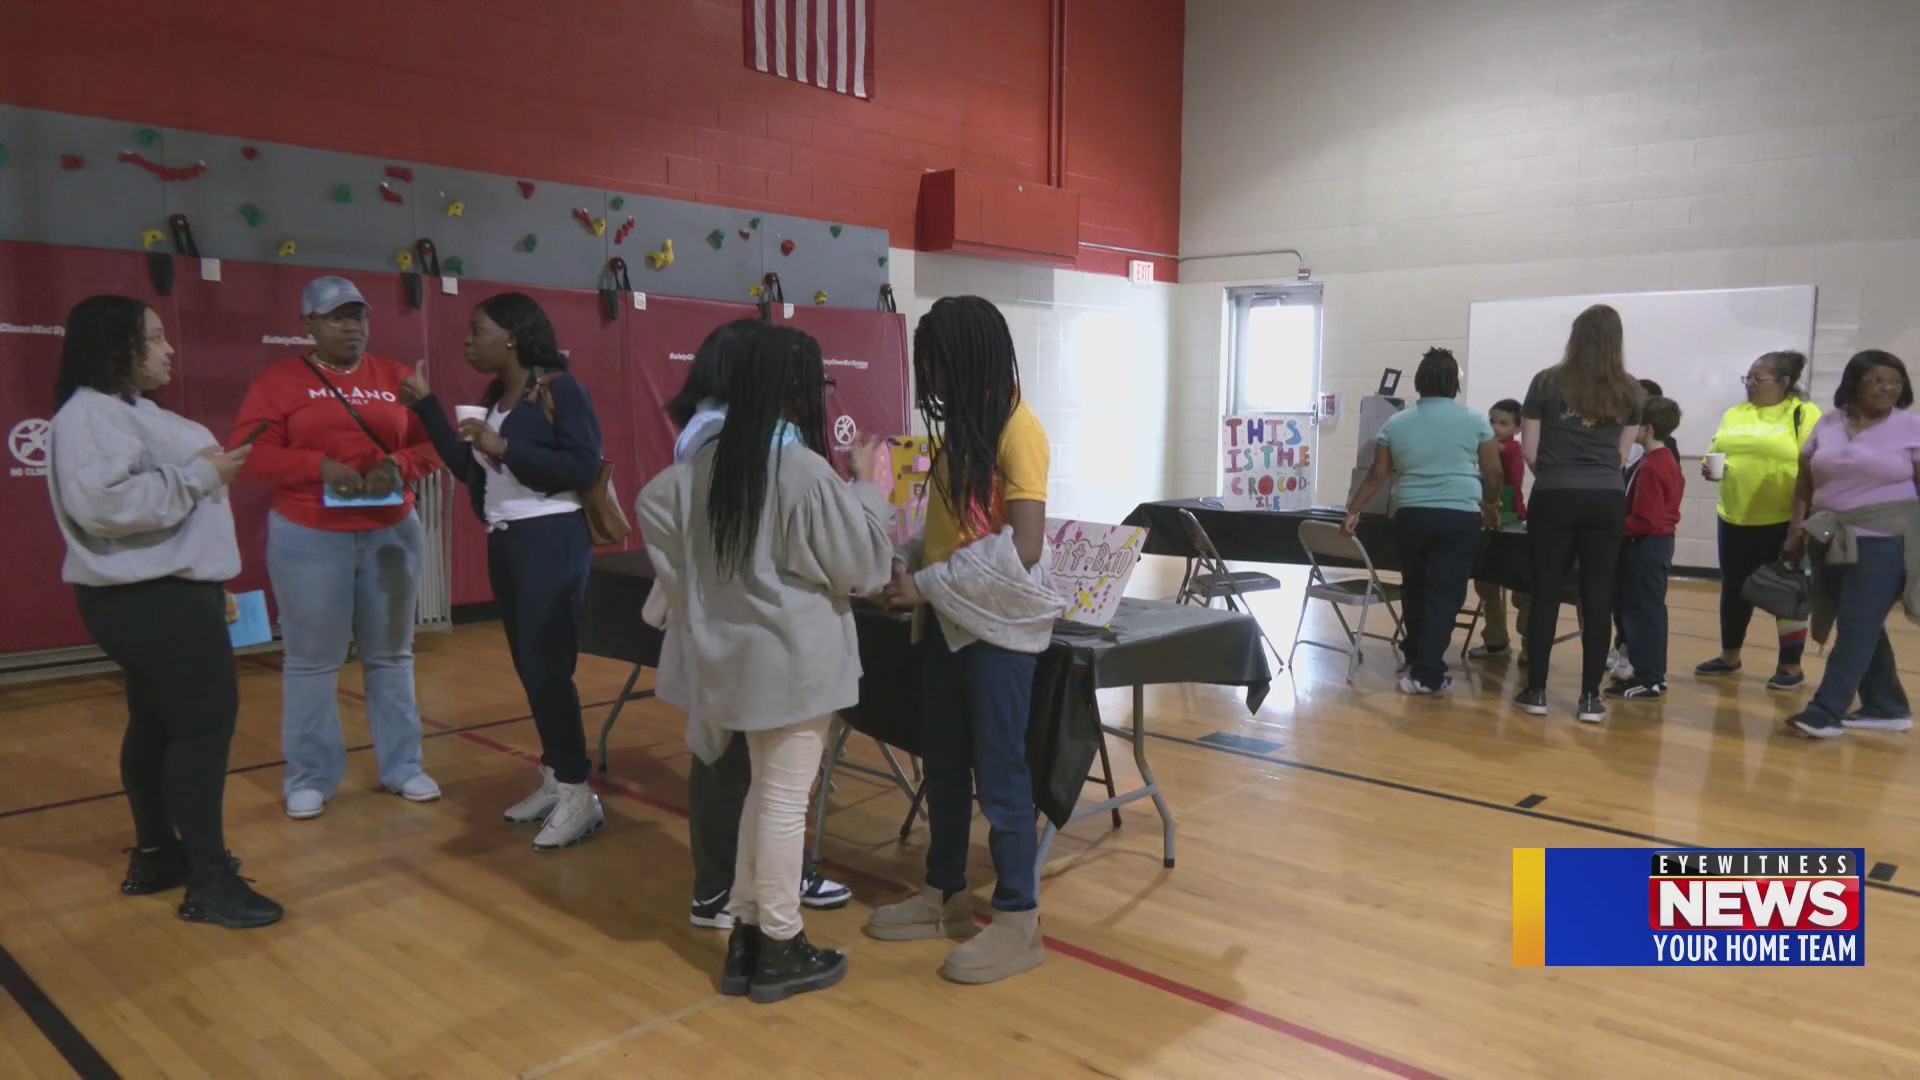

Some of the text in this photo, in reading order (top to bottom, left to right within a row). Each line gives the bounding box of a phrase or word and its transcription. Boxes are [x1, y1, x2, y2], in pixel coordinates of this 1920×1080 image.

[1136, 263, 1152, 281] EXIT
[307, 386, 397, 402] MILANO
[1225, 418, 1302, 447] THIS
[1224, 445, 1310, 473] IS THE
[1255, 495, 1281, 511] ILE
